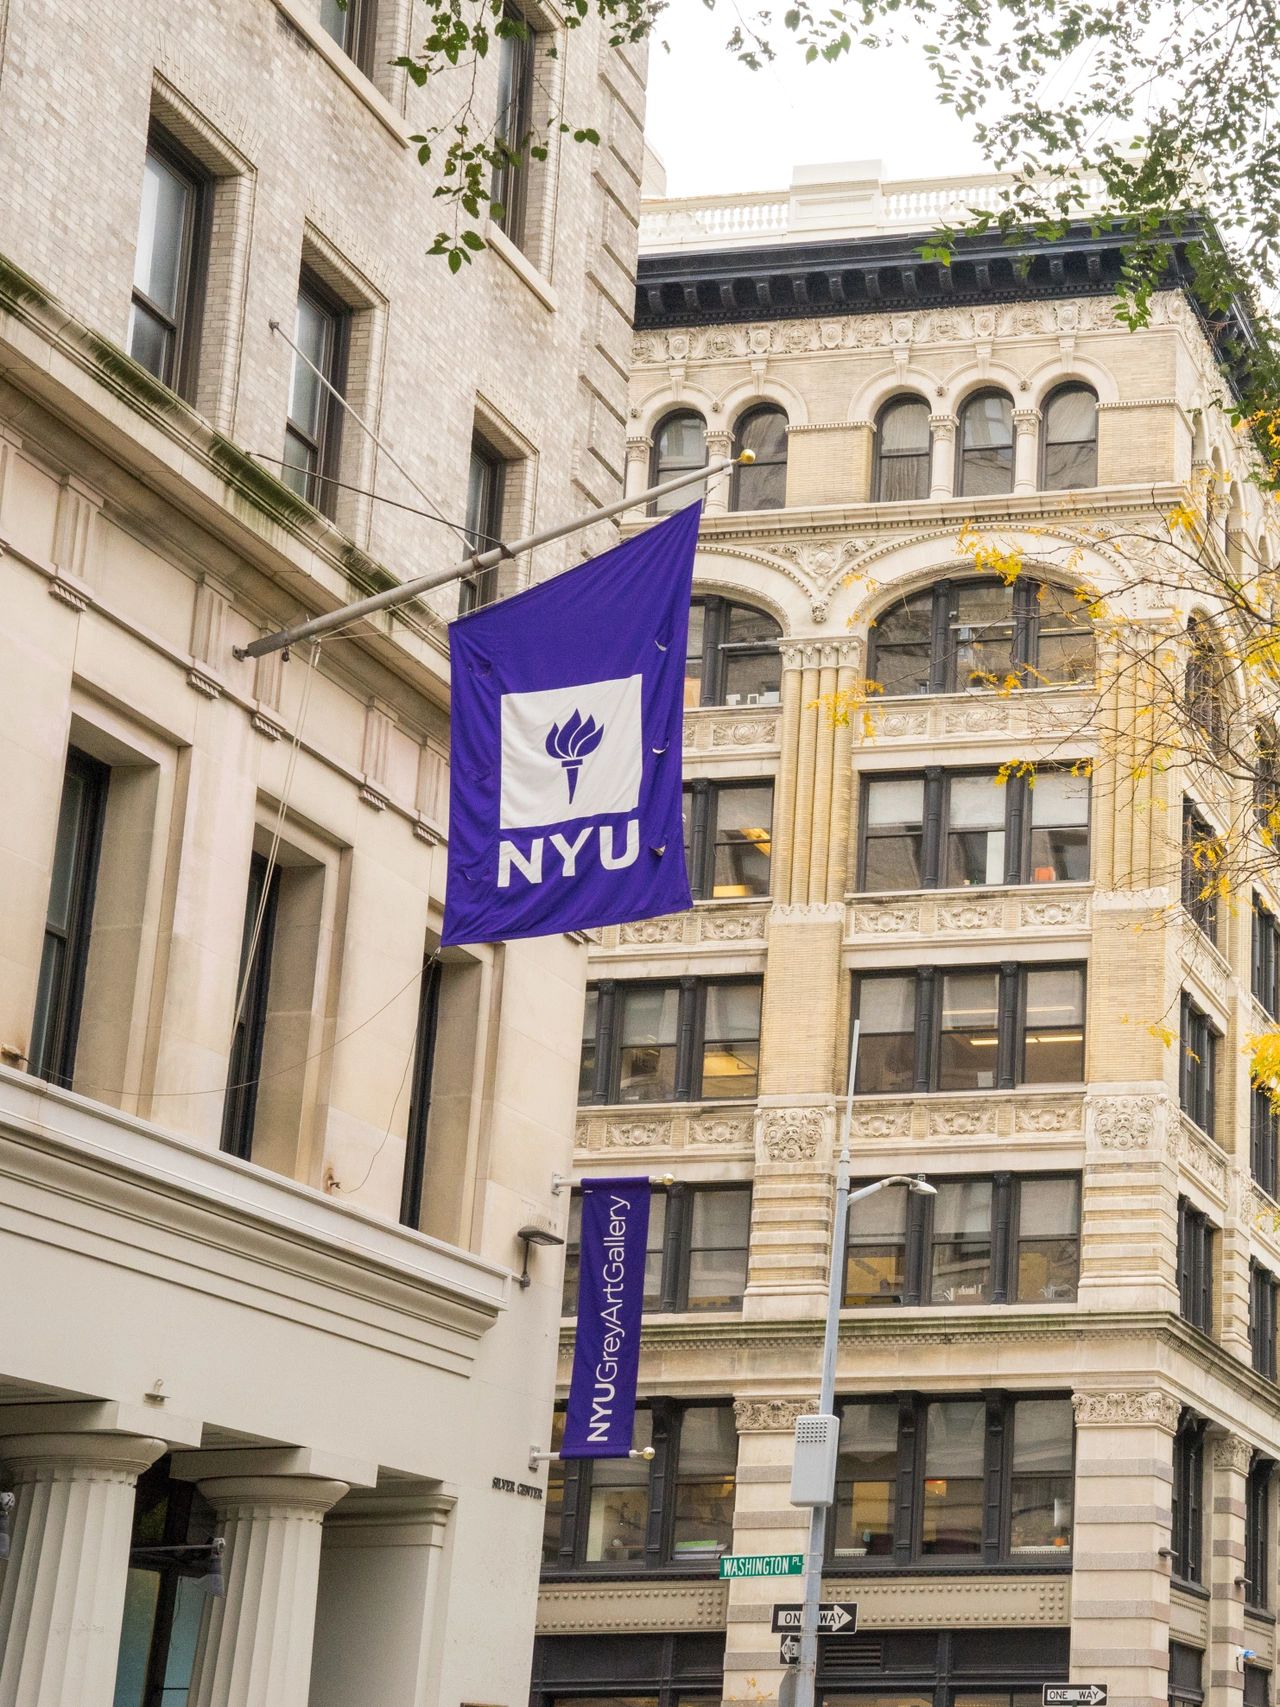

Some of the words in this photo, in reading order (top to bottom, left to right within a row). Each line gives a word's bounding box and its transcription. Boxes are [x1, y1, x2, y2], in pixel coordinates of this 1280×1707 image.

[497, 819, 640, 888] NYU
[492, 1477, 515, 1492] SILVER
[517, 1483, 543, 1500] CENTER
[723, 1556, 789, 1577] WASHINGTON
[791, 1556, 802, 1566] PL
[784, 1612, 802, 1625] ON
[819, 1612, 844, 1625] WAY
[784, 1643, 796, 1656] ONE
[1049, 1690, 1068, 1700] ONE
[1078, 1690, 1099, 1700] WAY
